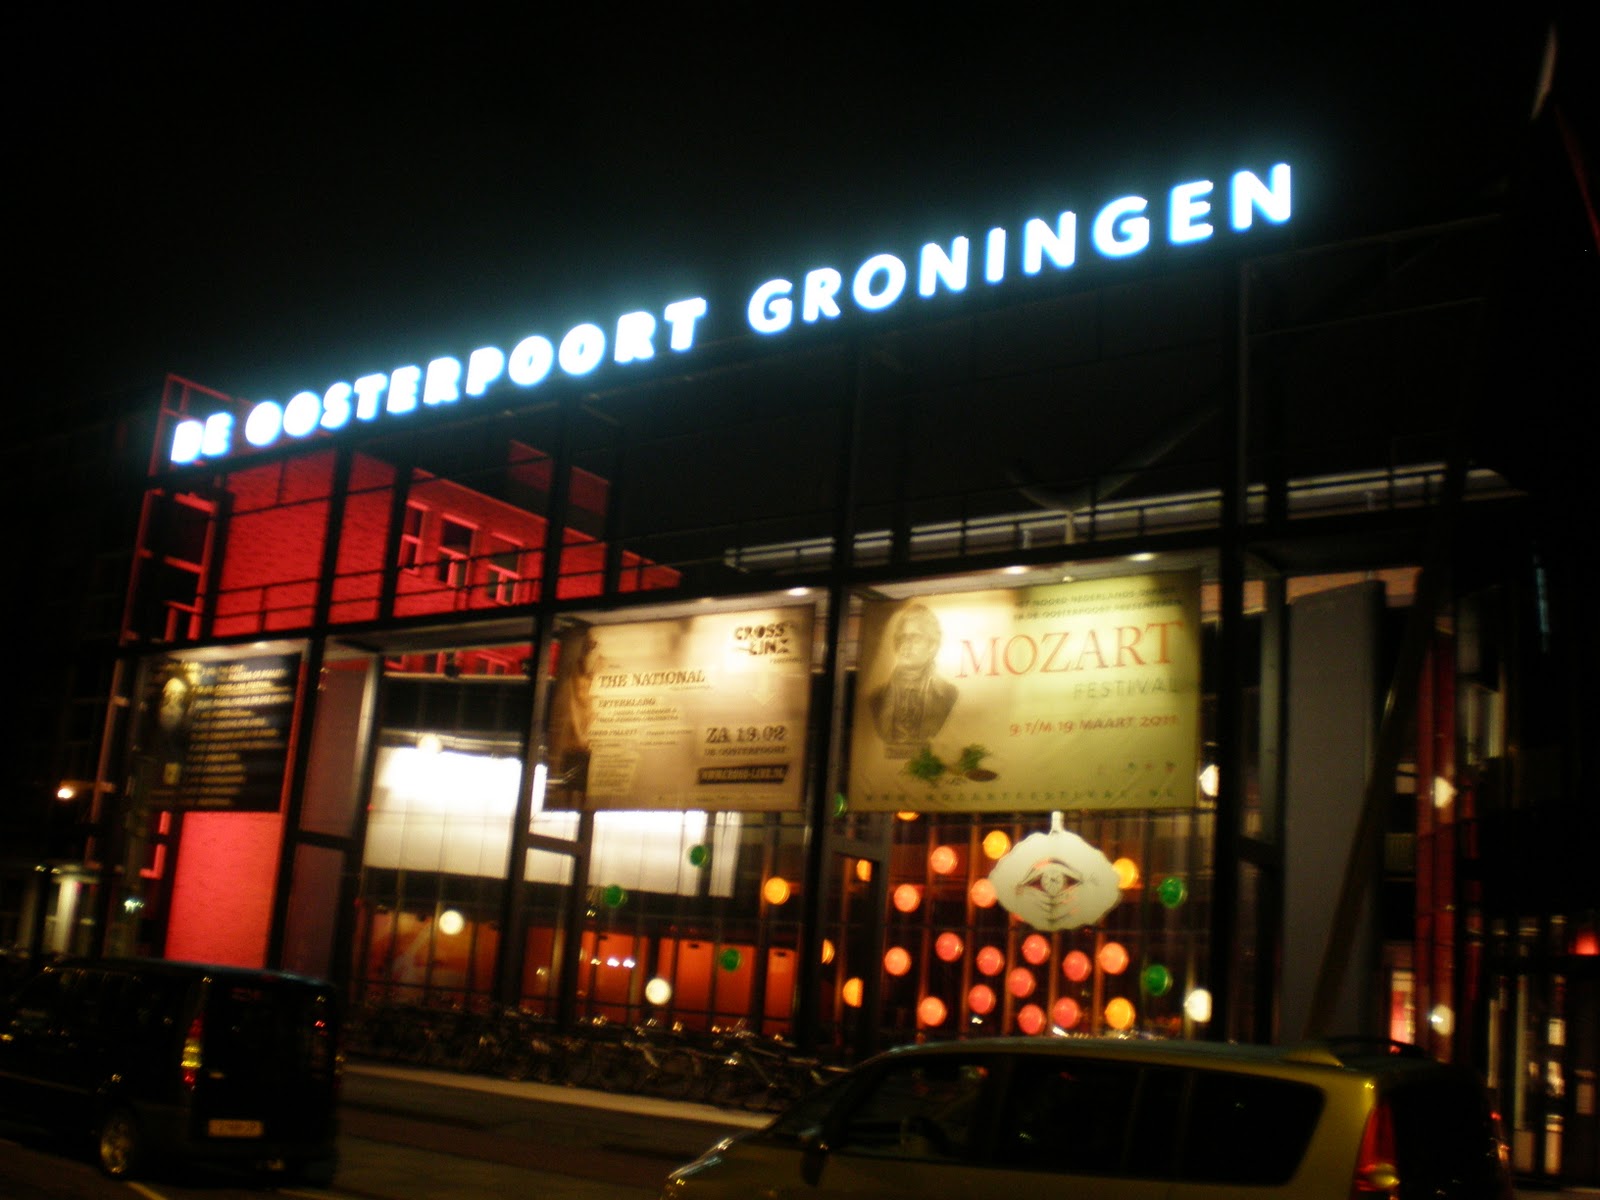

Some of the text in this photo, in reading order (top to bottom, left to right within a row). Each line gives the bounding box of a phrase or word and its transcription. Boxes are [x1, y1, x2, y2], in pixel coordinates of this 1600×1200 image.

[170, 162, 1293, 465] DE OOSTERPOORT GRONINGEN
[955, 620, 1185, 678] MOZART
[598, 670, 706, 688] THE NATIONAL
[1073, 677, 1181, 701] FESTIVAL
[705, 726, 732, 745] ZA
[1024, 718, 1053, 736] T/M
[1079, 716, 1134, 732] MAART
